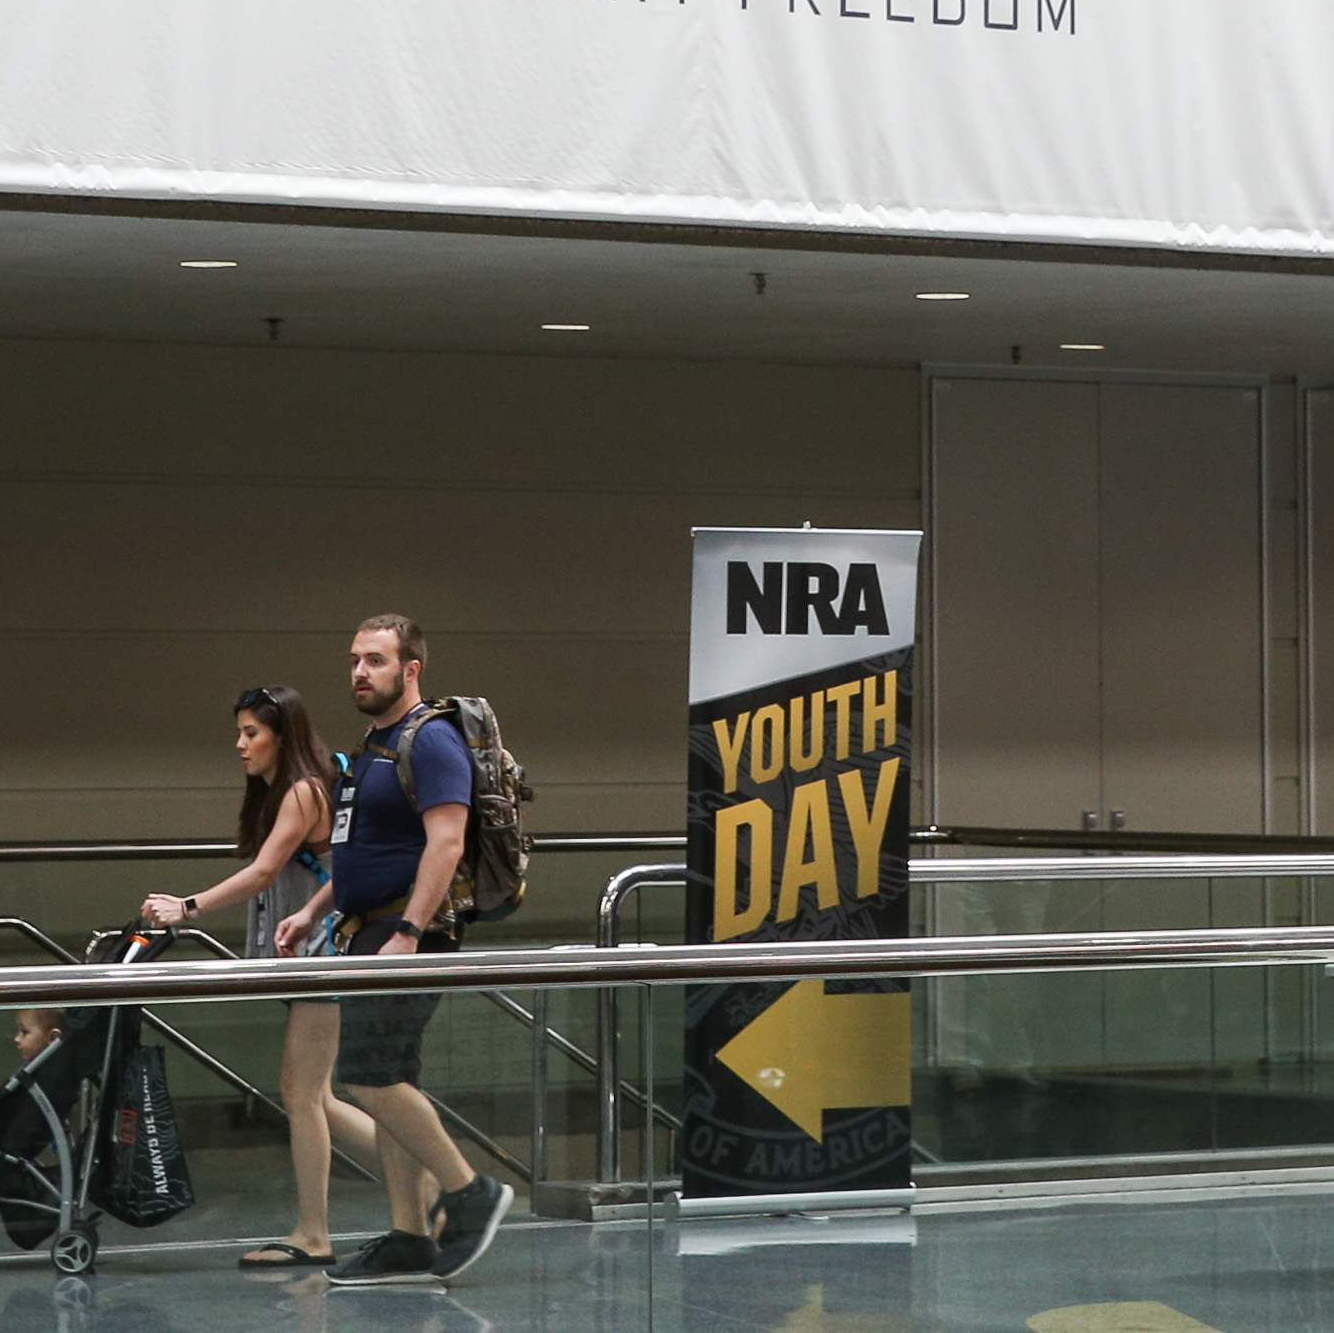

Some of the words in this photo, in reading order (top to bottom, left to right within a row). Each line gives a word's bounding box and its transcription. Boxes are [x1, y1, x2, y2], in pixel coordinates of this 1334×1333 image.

[725, 560, 890, 637] NRA
[711, 668, 898, 795] YOUTH
[713, 756, 901, 944] DAY
[689, 1124, 740, 1165] OF
[743, 1112, 910, 1177] AMERICA
